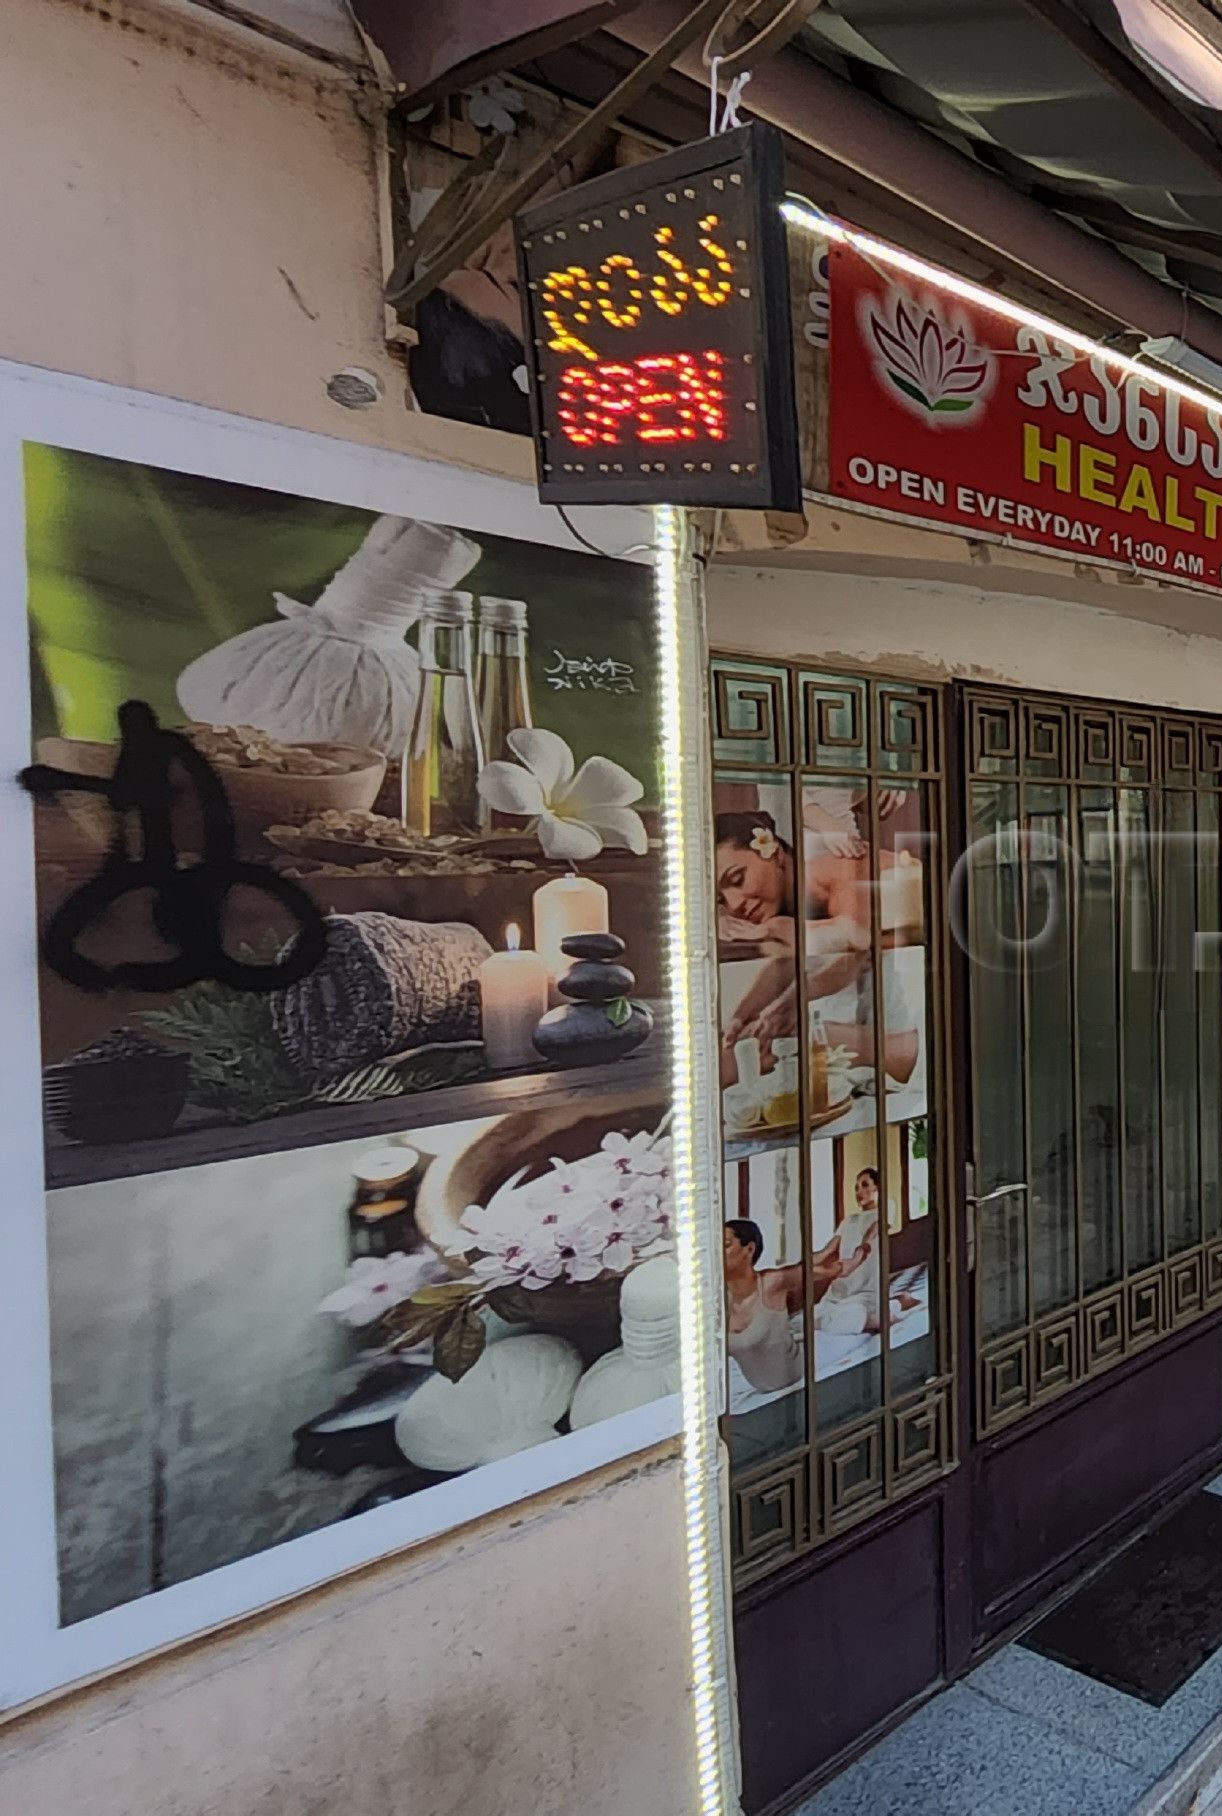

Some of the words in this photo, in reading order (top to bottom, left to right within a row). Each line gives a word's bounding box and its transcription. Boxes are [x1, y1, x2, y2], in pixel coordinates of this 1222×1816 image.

[558, 349, 727, 447] OPEN
[848, 456, 946, 505] OPEN
[956, 486, 1102, 547] EVERYDAY
[1109, 532, 1168, 566] 11:00
[1173, 551, 1205, 577] AM
